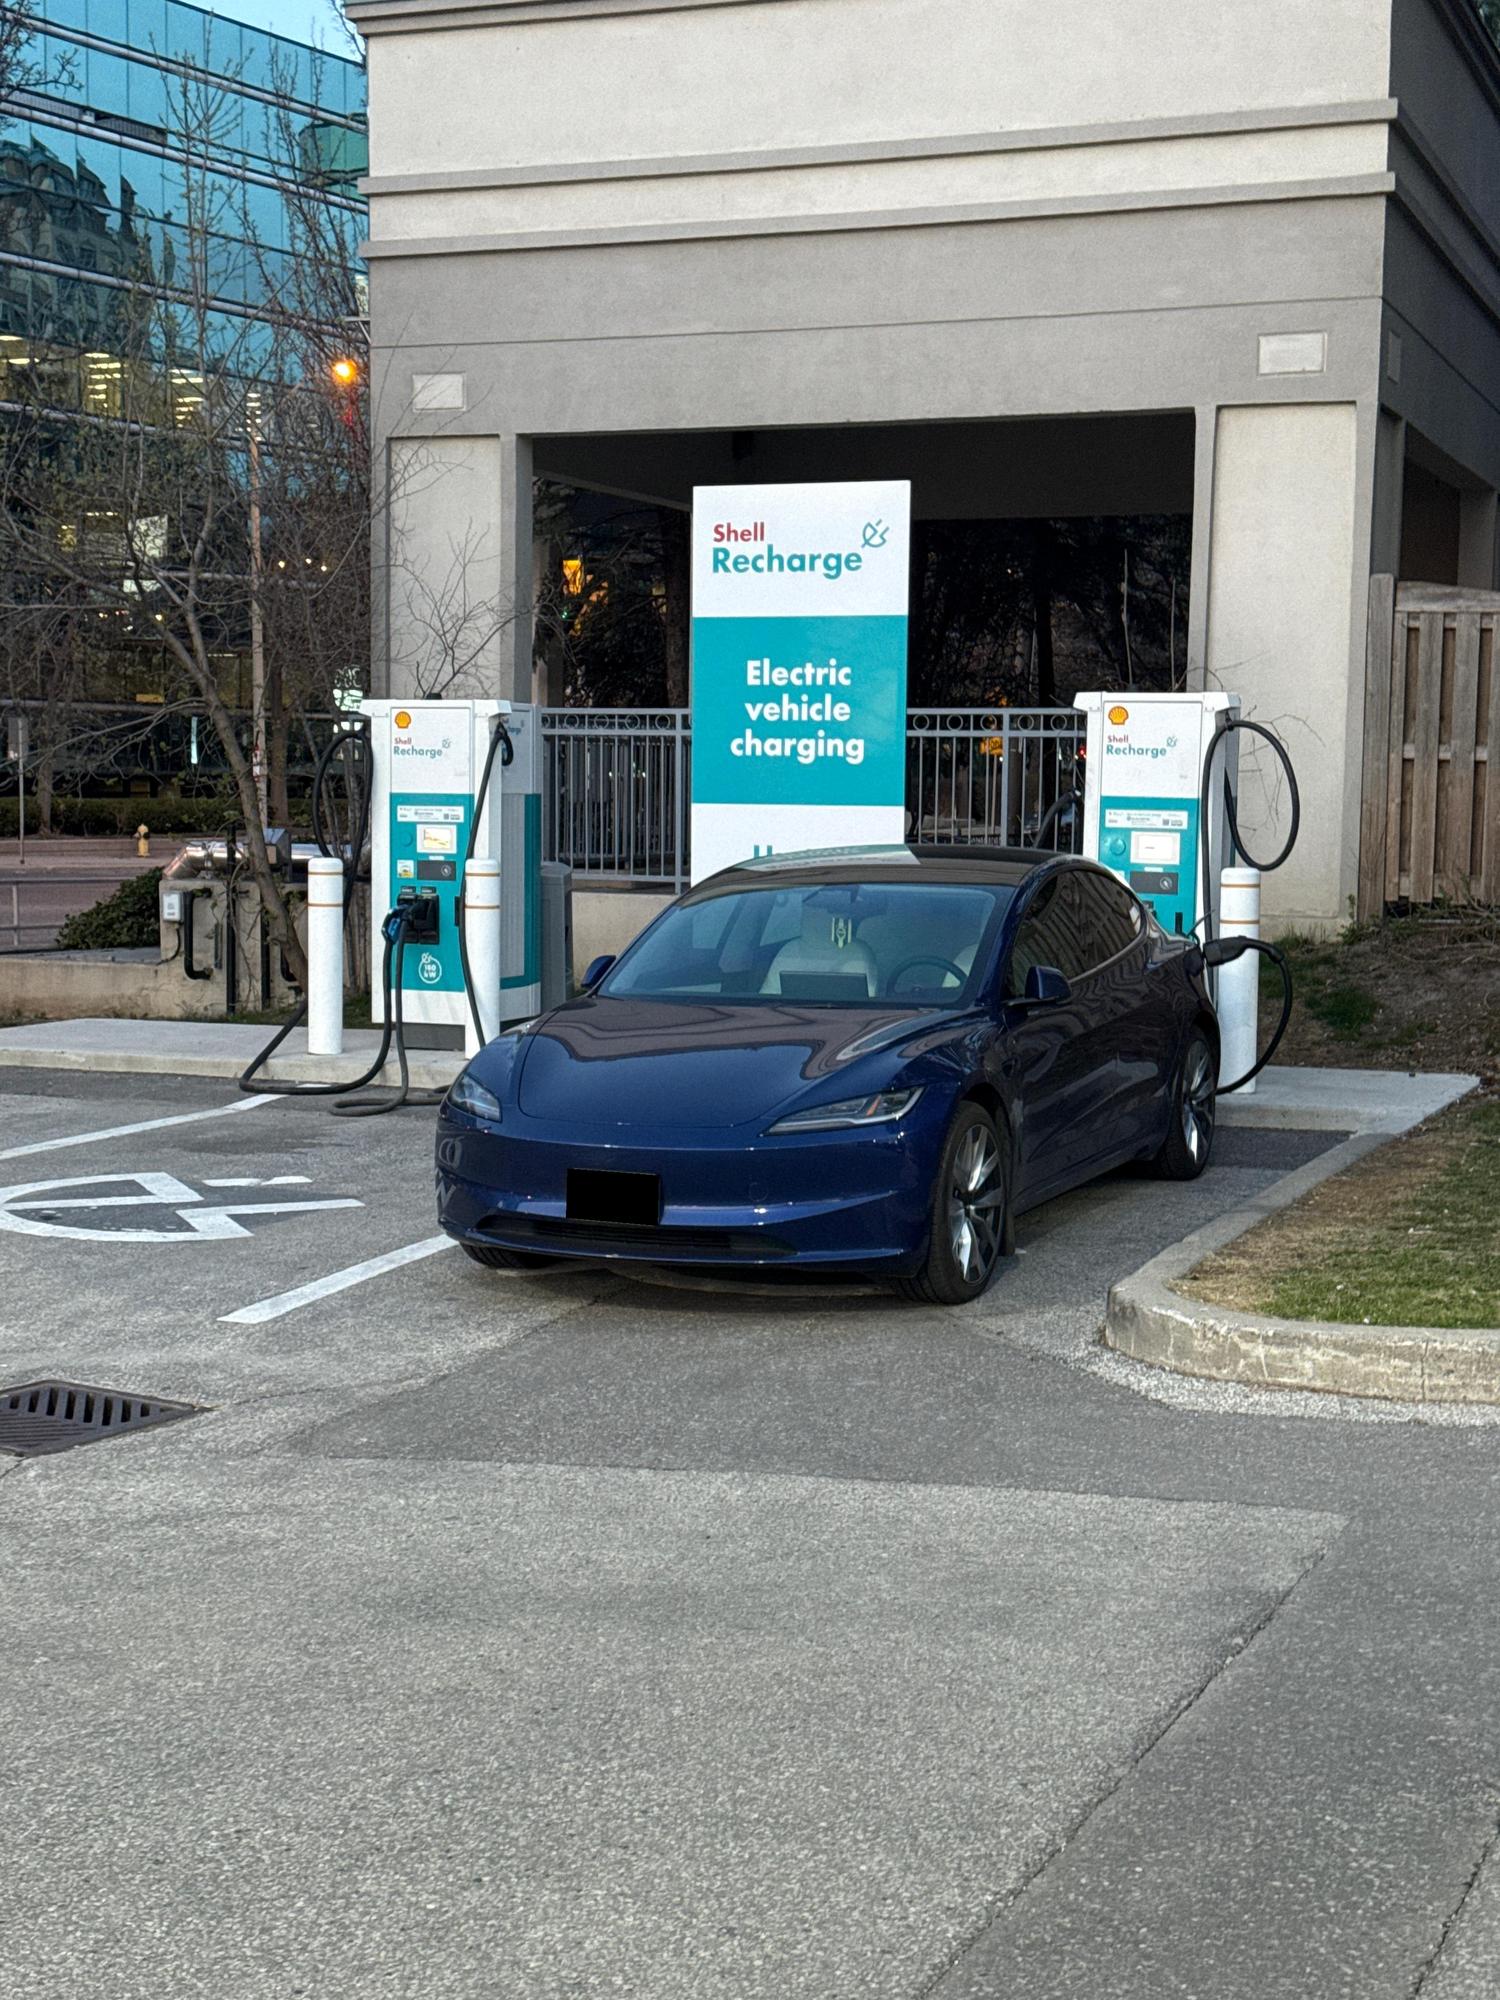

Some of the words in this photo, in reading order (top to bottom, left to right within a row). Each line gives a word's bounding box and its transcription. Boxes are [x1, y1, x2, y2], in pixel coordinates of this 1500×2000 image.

[713, 521, 765, 543] Shell
[712, 544, 862, 580] Recharge
[746, 658, 852, 686] Electric
[744, 693, 851, 722] vehicle
[394, 736, 412, 745] Shell
[730, 729, 865, 765] charging
[1107, 734, 1129, 743] Shell
[393, 745, 443, 759] Recharge
[1106, 743, 1167, 759] Recharge
